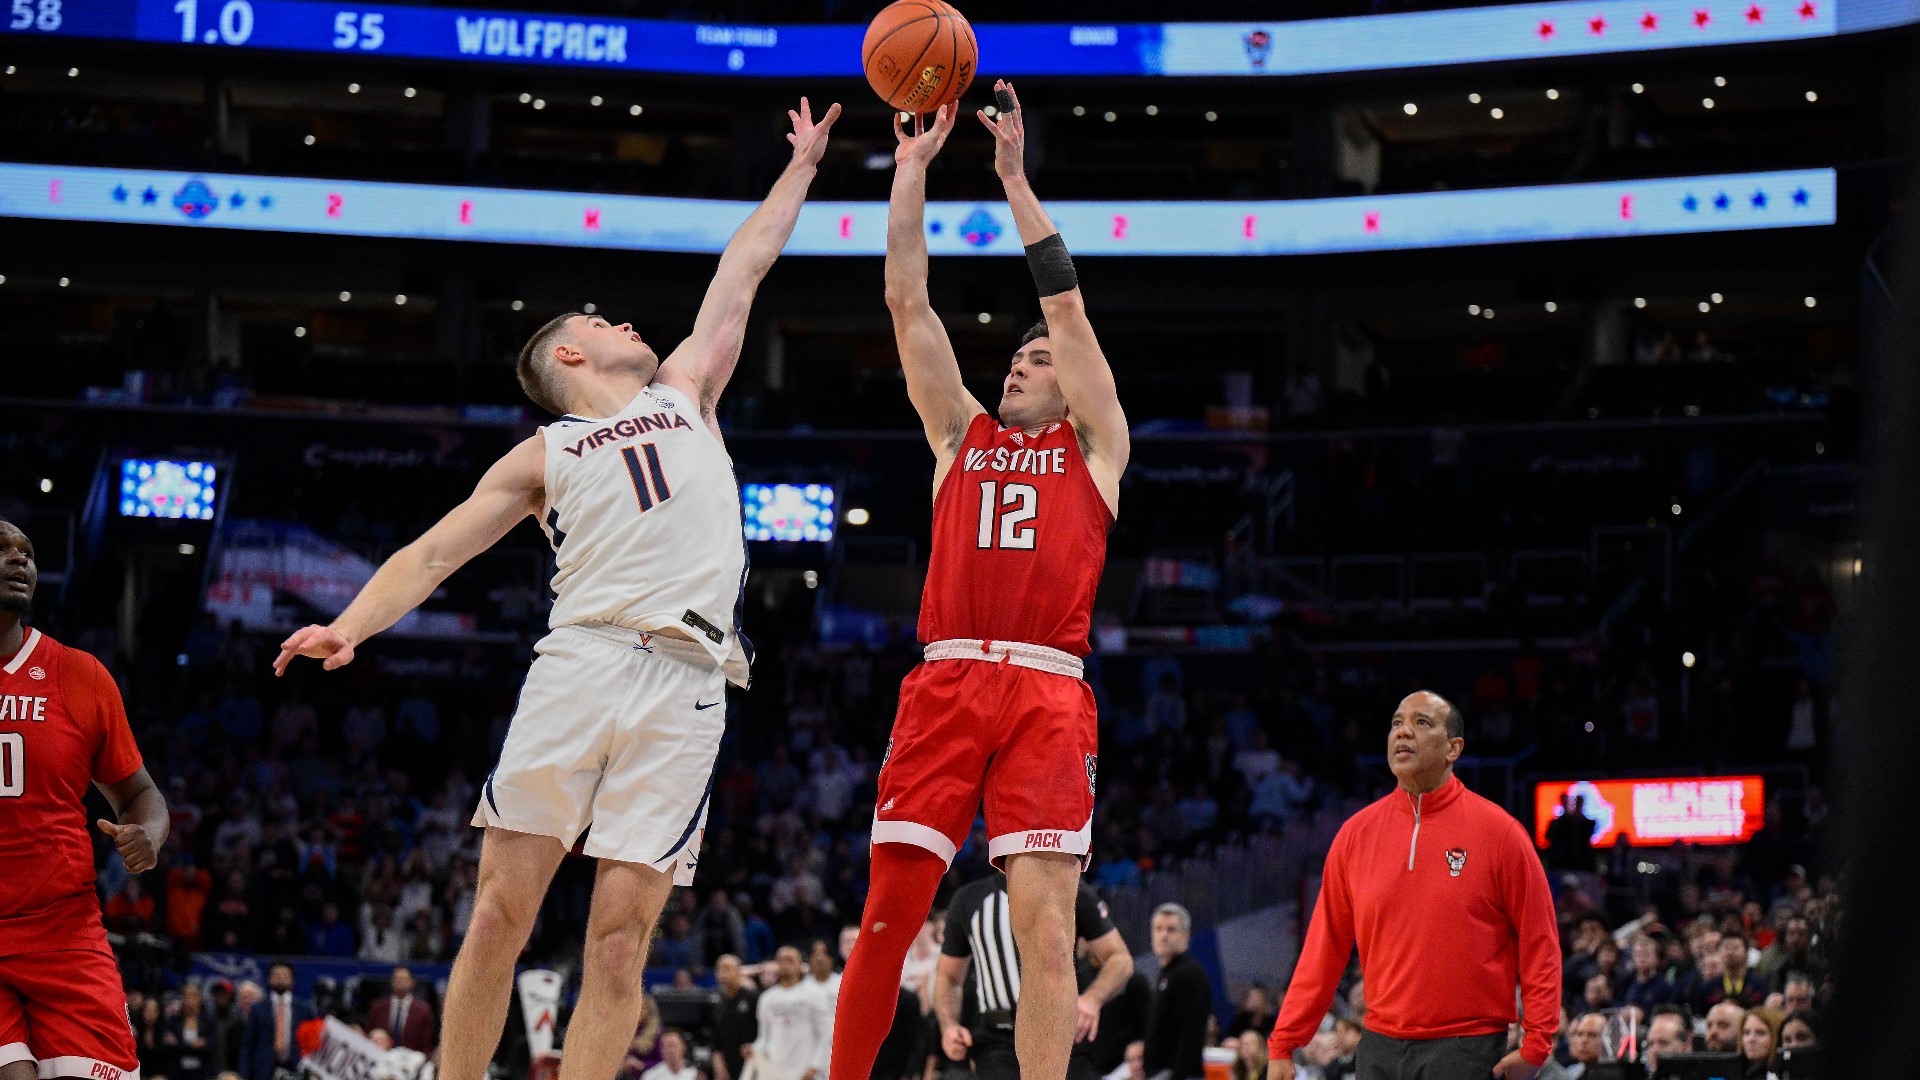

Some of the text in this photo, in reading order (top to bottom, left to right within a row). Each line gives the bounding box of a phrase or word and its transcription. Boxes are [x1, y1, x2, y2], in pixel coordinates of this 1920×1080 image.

[10, 0, 62, 31] 58
[173, 0, 254, 46] 1.0
[333, 11, 385, 50] 55
[456, 15, 628, 62] WOLFPACK
[562, 412, 694, 459] VIRGINIA
[620, 441, 672, 513] 11
[964, 445, 1066, 476] NC STATE
[977, 479, 1039, 550] 12
[0, 694, 48, 721] ATE
[1024, 832, 1063, 849] PACK
[90, 1062, 122, 1080] PACK
